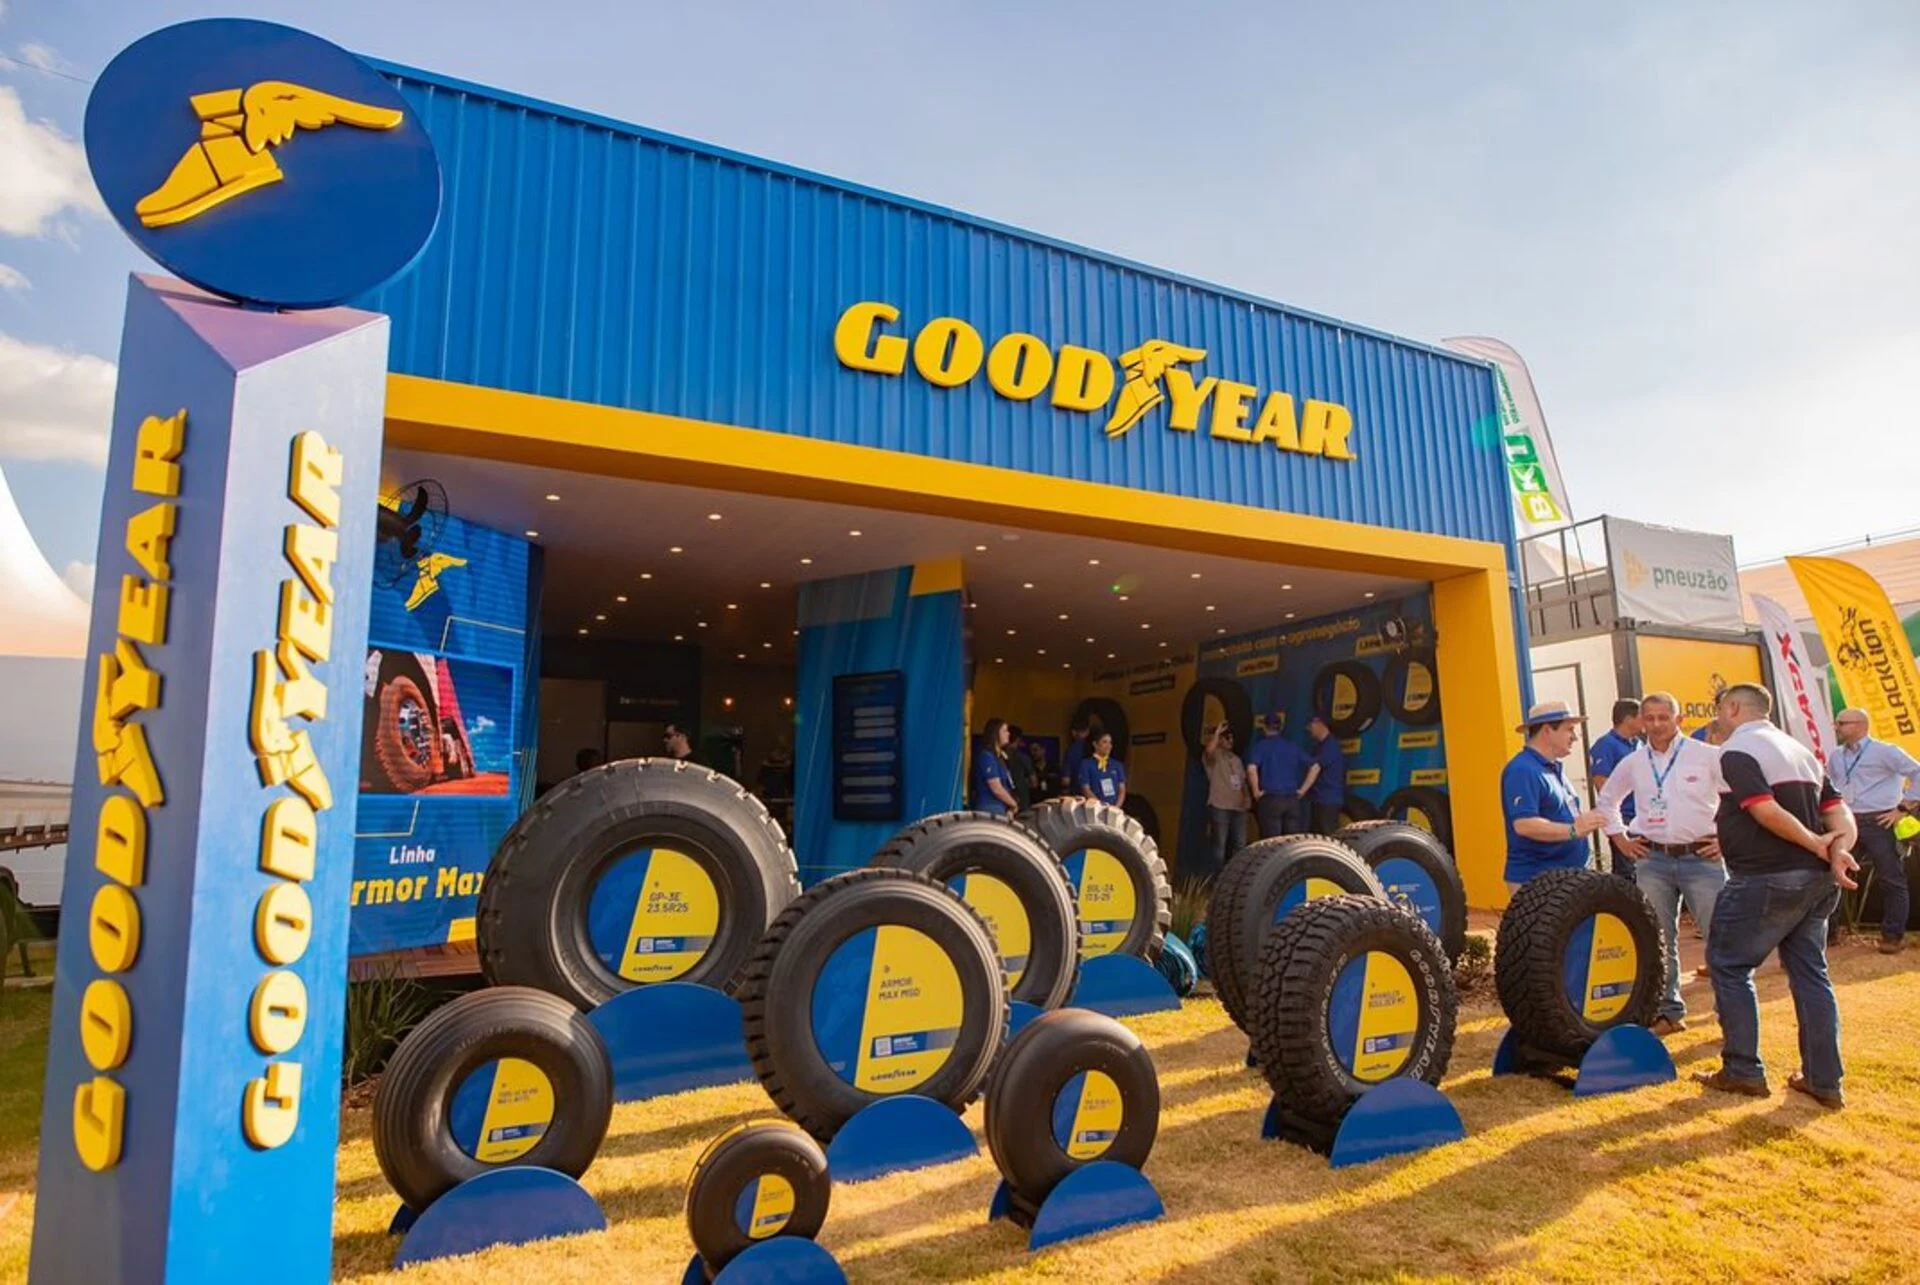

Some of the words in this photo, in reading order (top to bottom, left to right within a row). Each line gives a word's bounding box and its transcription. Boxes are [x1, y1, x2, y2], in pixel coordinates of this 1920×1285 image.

[834, 301, 1357, 461] GOODYEAR
[1505, 437, 1558, 522] BKT
[1652, 565, 1729, 593] pneuzão
[74, 407, 189, 1172] GOODYEAR
[242, 429, 344, 1150] GOODYEAR
[350, 876, 429, 906] rmor
[389, 845, 436, 865] Linha
